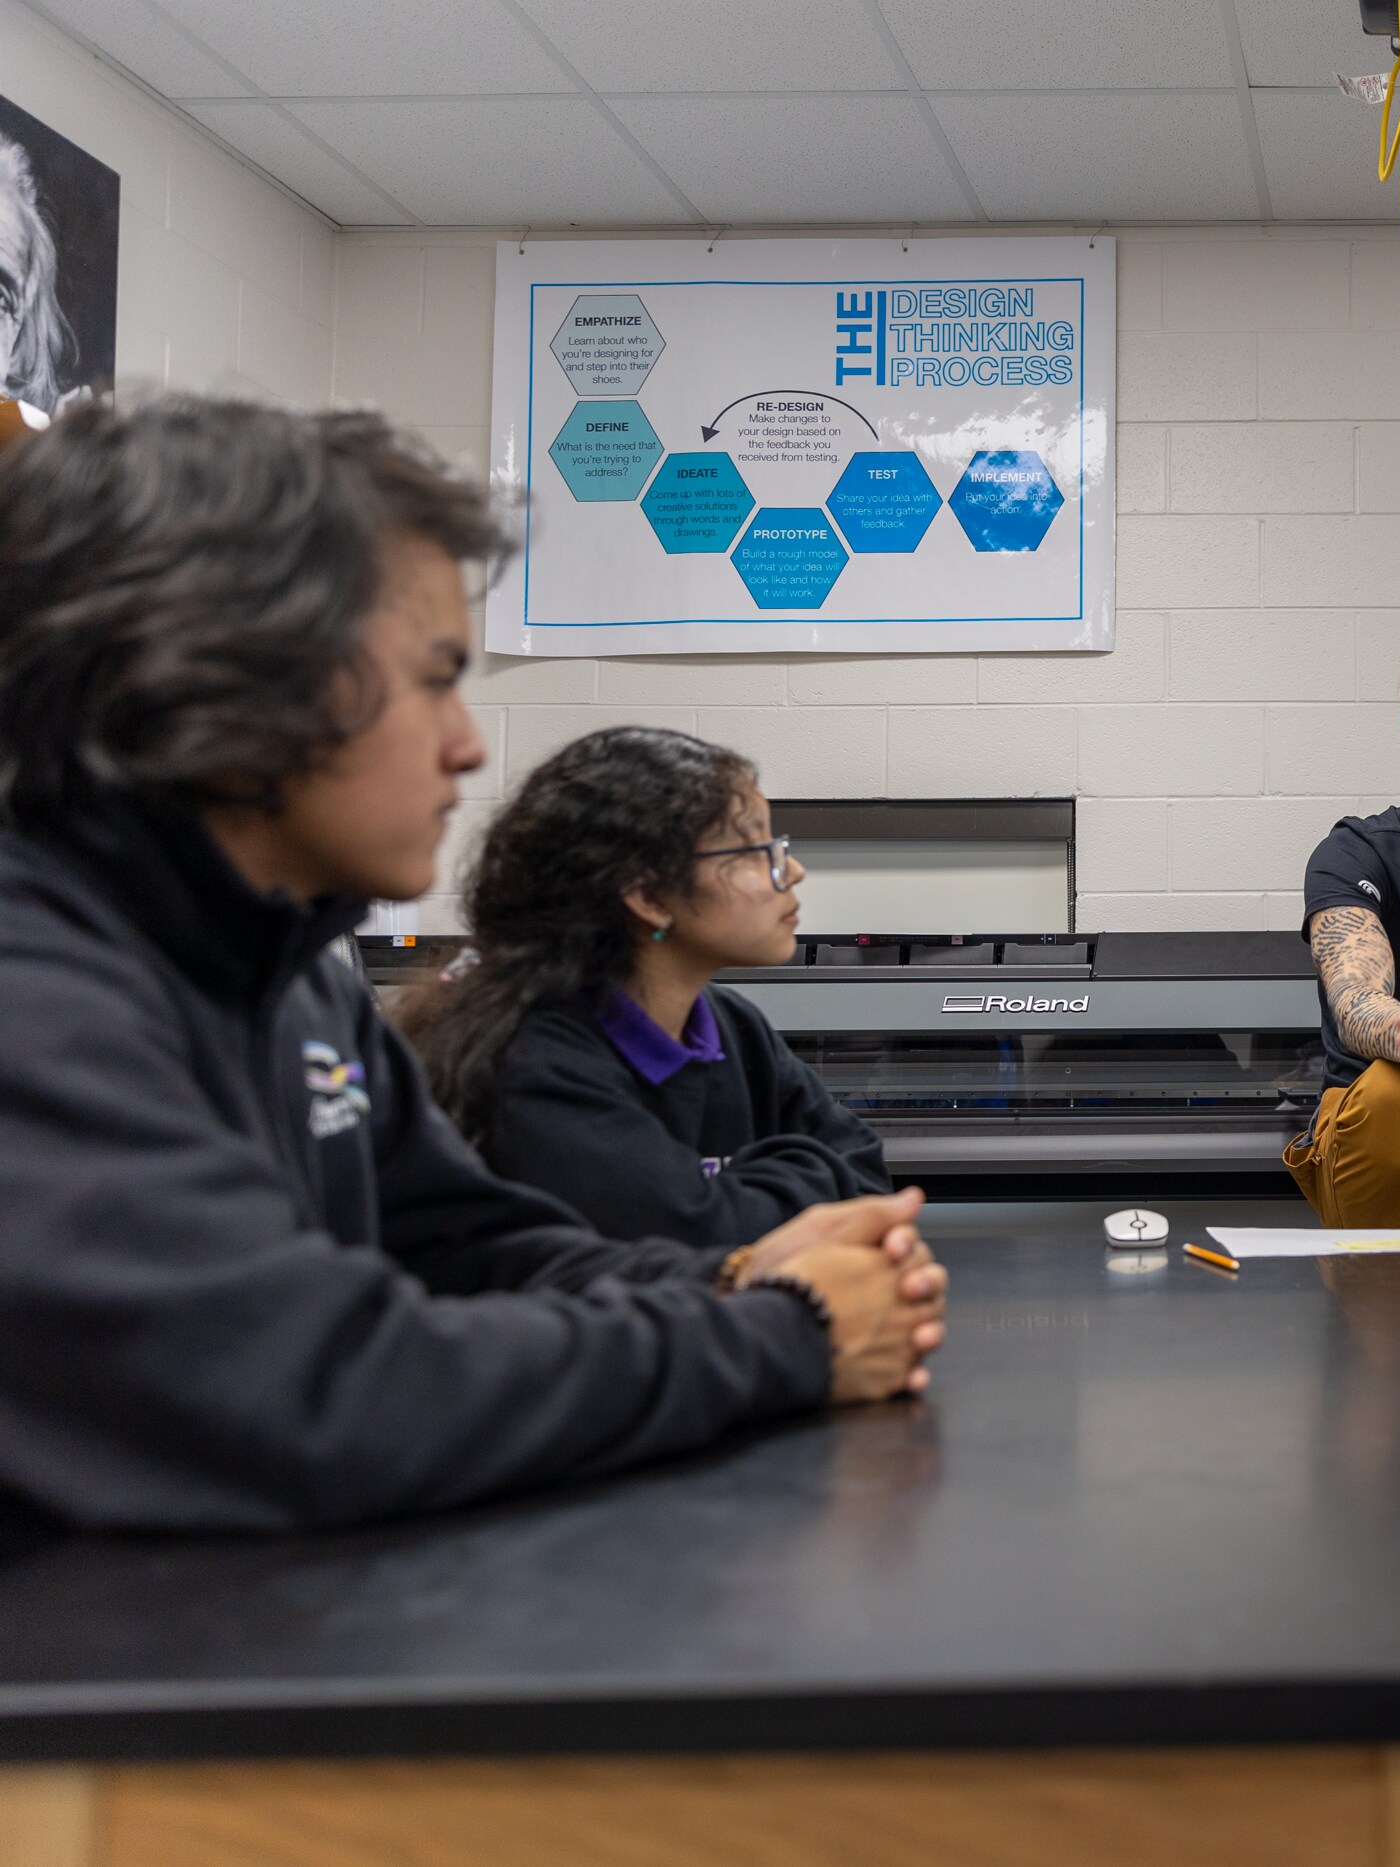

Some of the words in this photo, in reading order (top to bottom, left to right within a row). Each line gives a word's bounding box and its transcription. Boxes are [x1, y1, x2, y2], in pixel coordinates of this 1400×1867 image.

[891, 288, 1033, 318] DESIGN
[574, 316, 642, 327] EMPATHIZE
[568, 336, 595, 346] Learn
[597, 336, 625, 345] about
[627, 336, 648, 345] who
[836, 291, 872, 386] THE
[890, 321, 1074, 352] THINKING
[561, 350, 592, 360] you're
[593, 349, 639, 360] designing
[641, 348, 654, 357] for
[565, 362, 584, 371] and
[586, 363, 607, 373] step
[609, 362, 628, 371] into
[629, 361, 650, 370] their
[891, 355, 1073, 387] PROCESS
[592, 375, 623, 384] shoes.
[756, 402, 824, 412] RE-DESIGN
[748, 414, 776, 423] Make
[778, 414, 819, 425] changes
[821, 415, 832, 423] to
[586, 422, 630, 432] DEFINE
[737, 428, 760, 438] your
[761, 427, 794, 438] design
[796, 427, 827, 436] based
[828, 428, 841, 436] on
[557, 442, 582, 452] What
[584, 442, 593, 451] is
[595, 442, 610, 451] the
[612, 441, 636, 451] need
[638, 441, 656, 450] that
[748, 440, 765, 449] the
[766, 439, 811, 449] feedback
[812, 441, 831, 450] you
[572, 455, 602, 466] you're
[604, 455, 630, 466] trying
[632, 455, 642, 464] to
[738, 453, 779, 462] received
[781, 452, 803, 462] from
[805, 452, 840, 464] testing.
[585, 467, 629, 477] address?
[677, 468, 718, 479] IDEATE
[867, 469, 899, 480] TEST
[970, 472, 1042, 483] IMPLEMENT
[649, 490, 678, 499] Come
[680, 491, 692, 499] up
[694, 488, 714, 498] with
[716, 488, 734, 498] lots
[736, 488, 747, 498] of
[836, 493, 865, 503] Share
[867, 494, 888, 505] your
[890, 493, 911, 502] idea
[912, 493, 933, 502] with
[965, 492, 982, 501] Put
[984, 493, 1005, 503] your
[1007, 492, 1028, 501] idea
[1030, 492, 1048, 501] into
[657, 502, 693, 512] creative
[694, 501, 738, 511] solutions
[842, 507, 872, 516] others
[875, 506, 893, 516] and
[895, 507, 926, 517] gather
[990, 505, 1022, 515] action.
[653, 515, 689, 526] through
[690, 515, 720, 524] words
[722, 514, 742, 524] and
[861, 519, 907, 529] feedback.
[673, 528, 719, 539] drawings.
[753, 529, 828, 540] PROTOTYPE
[742, 548, 767, 559] Build
[769, 551, 775, 559] a
[777, 549, 806, 560] rough
[808, 548, 838, 559] model
[740, 562, 750, 572] of
[751, 562, 776, 571] what
[779, 563, 800, 573] your
[802, 562, 823, 572] idea
[825, 562, 840, 571] will
[748, 575, 769, 584] look
[771, 575, 788, 584] like
[789, 575, 808, 584] and
[810, 575, 832, 584] how
[763, 589, 769, 597] it
[771, 588, 787, 597] will
[789, 588, 816, 597] work.
[985, 995, 1089, 1012] Roland
